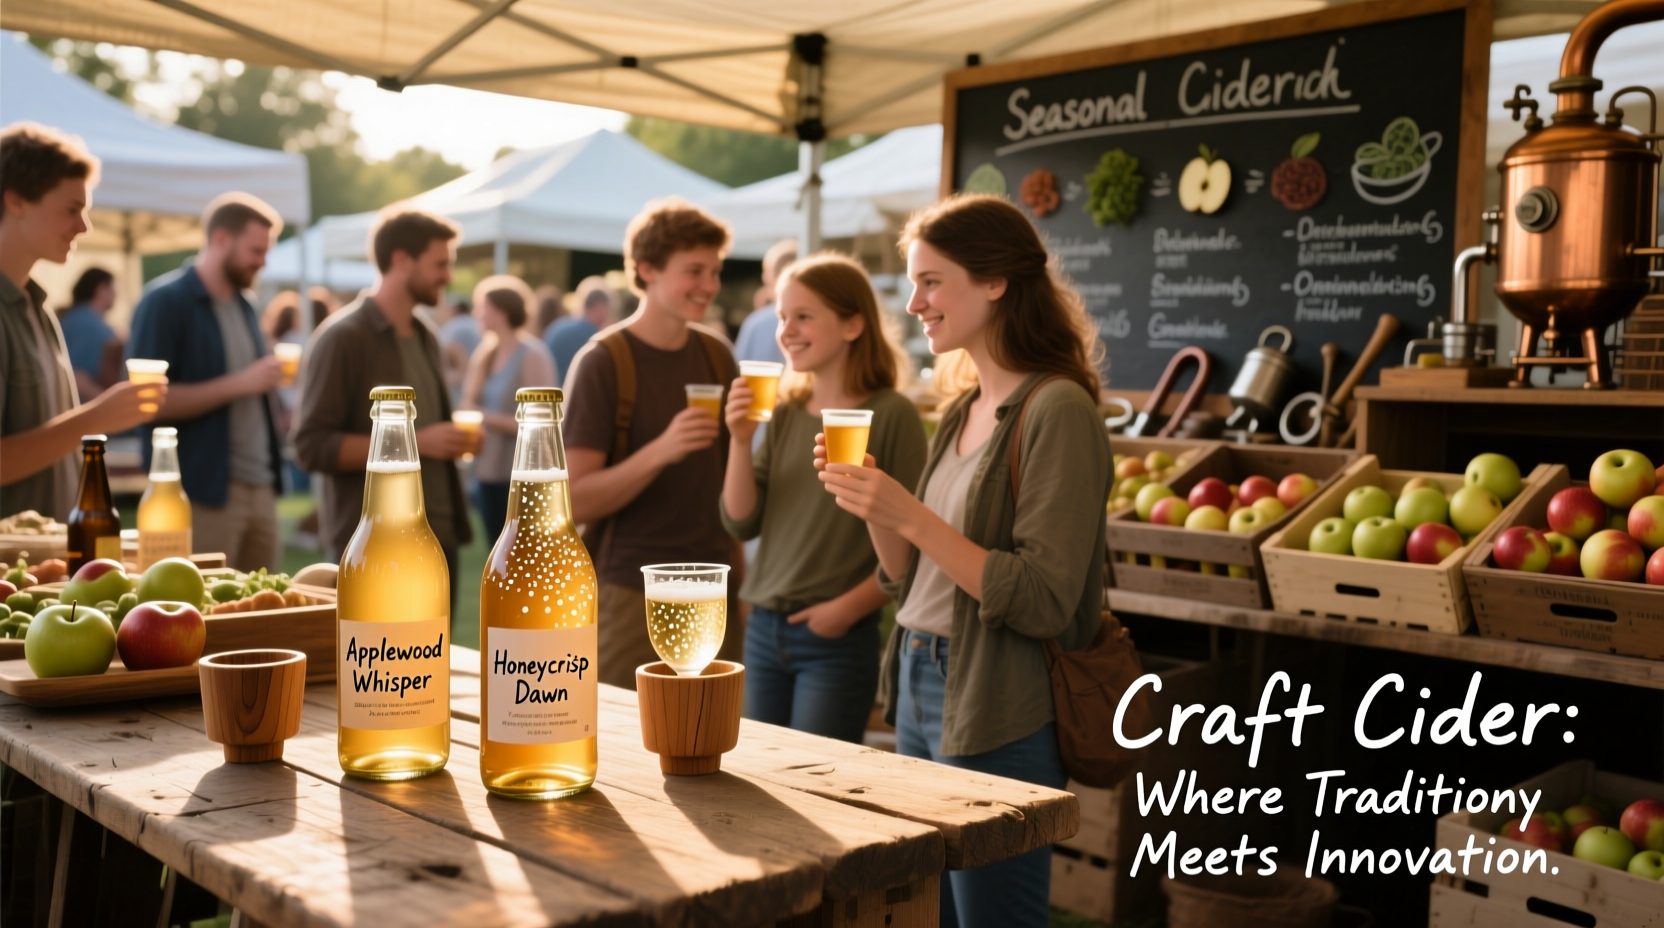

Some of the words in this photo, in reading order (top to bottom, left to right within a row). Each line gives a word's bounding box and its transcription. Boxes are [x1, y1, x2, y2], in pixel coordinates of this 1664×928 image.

[1003, 70, 1148, 140] Seasonal
[346, 633, 443, 669] Applewood
[494, 649, 589, 682] Honeycrisp
[352, 670, 432, 698] Whisper
[514, 679, 568, 705] Dawn
